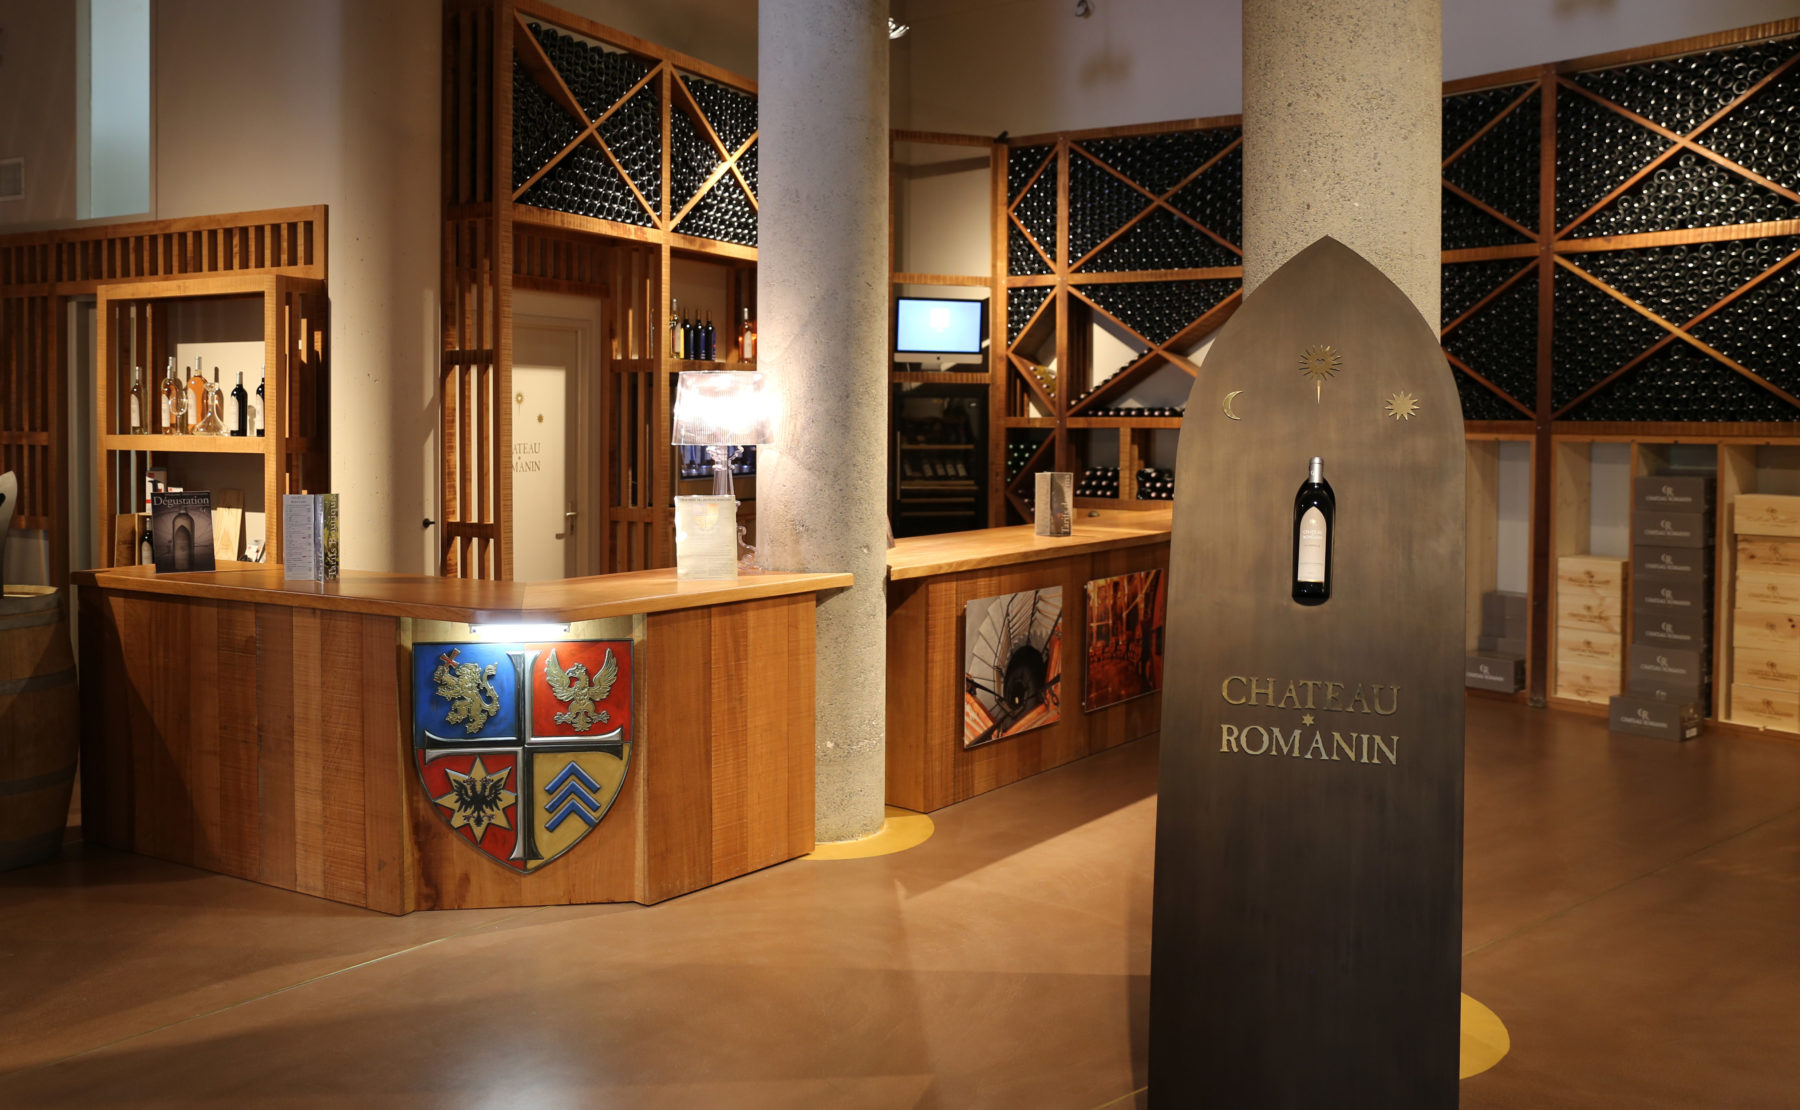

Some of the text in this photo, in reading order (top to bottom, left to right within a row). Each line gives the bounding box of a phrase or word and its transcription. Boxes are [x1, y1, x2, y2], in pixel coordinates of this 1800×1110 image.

[512, 442, 541, 454] ATEAU
[512, 461, 540, 472] MANIN
[153, 496, 209, 508] Dégustation
[328, 549, 337, 578] Tarifs
[1222, 676, 1400, 715] CHATEAU
[1220, 724, 1399, 765] ROMANIN
